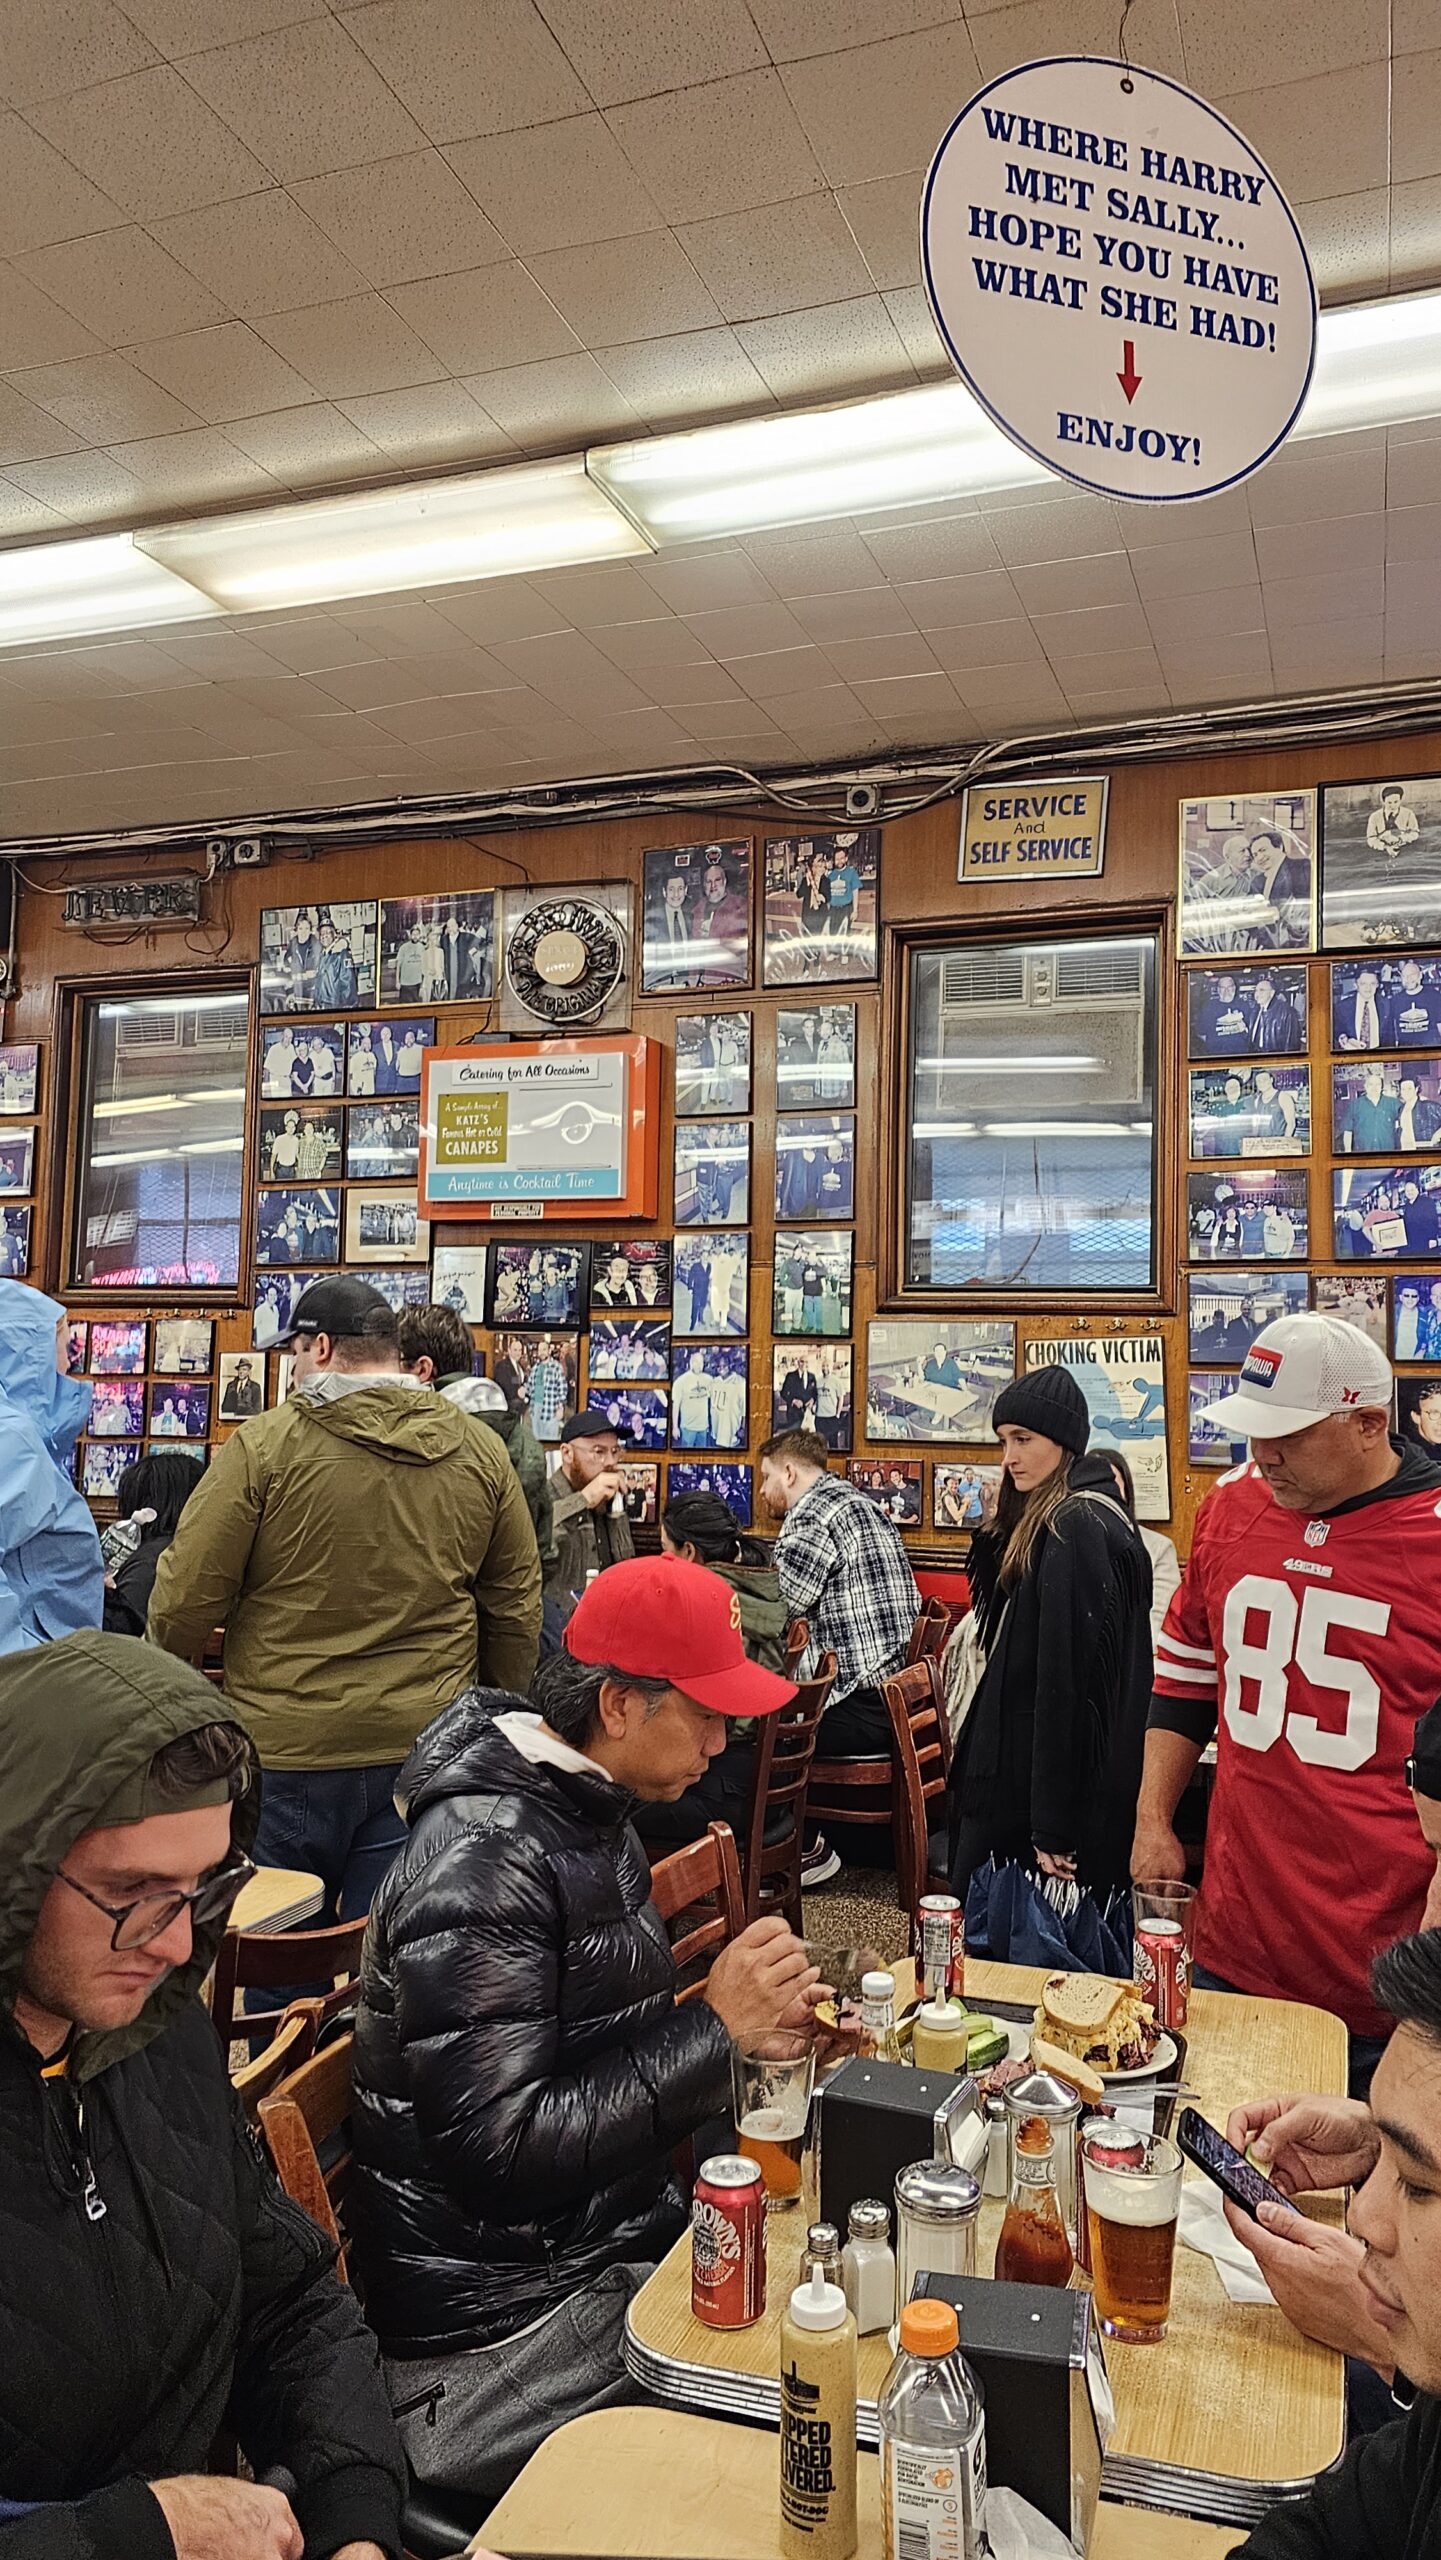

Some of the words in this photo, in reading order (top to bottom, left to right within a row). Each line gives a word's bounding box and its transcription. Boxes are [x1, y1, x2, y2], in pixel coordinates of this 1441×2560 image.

[981, 106, 1128, 171] WHERE
[1141, 147, 1265, 206] HARRY
[1005, 163, 1094, 211] MET
[1107, 187, 1245, 250] SALLY...
[968, 206, 1082, 259] HOPE
[1093, 233, 1172, 279] YOU
[1183, 255, 1279, 305] HAVE
[972, 258, 1087, 310] WHAT
[1100, 286, 1177, 331] SHE
[1190, 306, 1277, 353] HAD!
[1057, 412, 1202, 466] ENJOY!
[983, 794, 1088, 821] SERVICE
[1013, 821, 1046, 835] And
[970, 841, 1012, 865] SELF
[1016, 837, 1092, 863] SERVICE
[459, 1067, 504, 1081] Catering
[507, 1066, 522, 1080] for
[525, 1064, 543, 1078] All
[545, 1063, 590, 1077] Occasions
[445, 1102, 451, 1112] A
[456, 1113, 489, 1125] KATZ'S
[442, 1127, 464, 1138] Famous
[466, 1126, 477, 1138] Hot
[478, 1129, 485, 1137] or
[486, 1125, 502, 1137] Cold
[445, 1140, 499, 1156] CANAPES
[447, 1175, 495, 1195] Anytime
[498, 1176, 509, 1190] is
[513, 1173, 562, 1190] Cocktail
[566, 1171, 595, 1189] Time
[1026, 1340, 1097, 1366] CHOKING
[1102, 1339, 1161, 1364] VICTIM
[1282, 1557, 1333, 1579] 49ERS
[1222, 1574, 1391, 1772] 85
[693, 2198, 741, 2261] ROWN'S
[783, 2412, 832, 2446] IPPED
[784, 2435, 832, 2469] TERED
